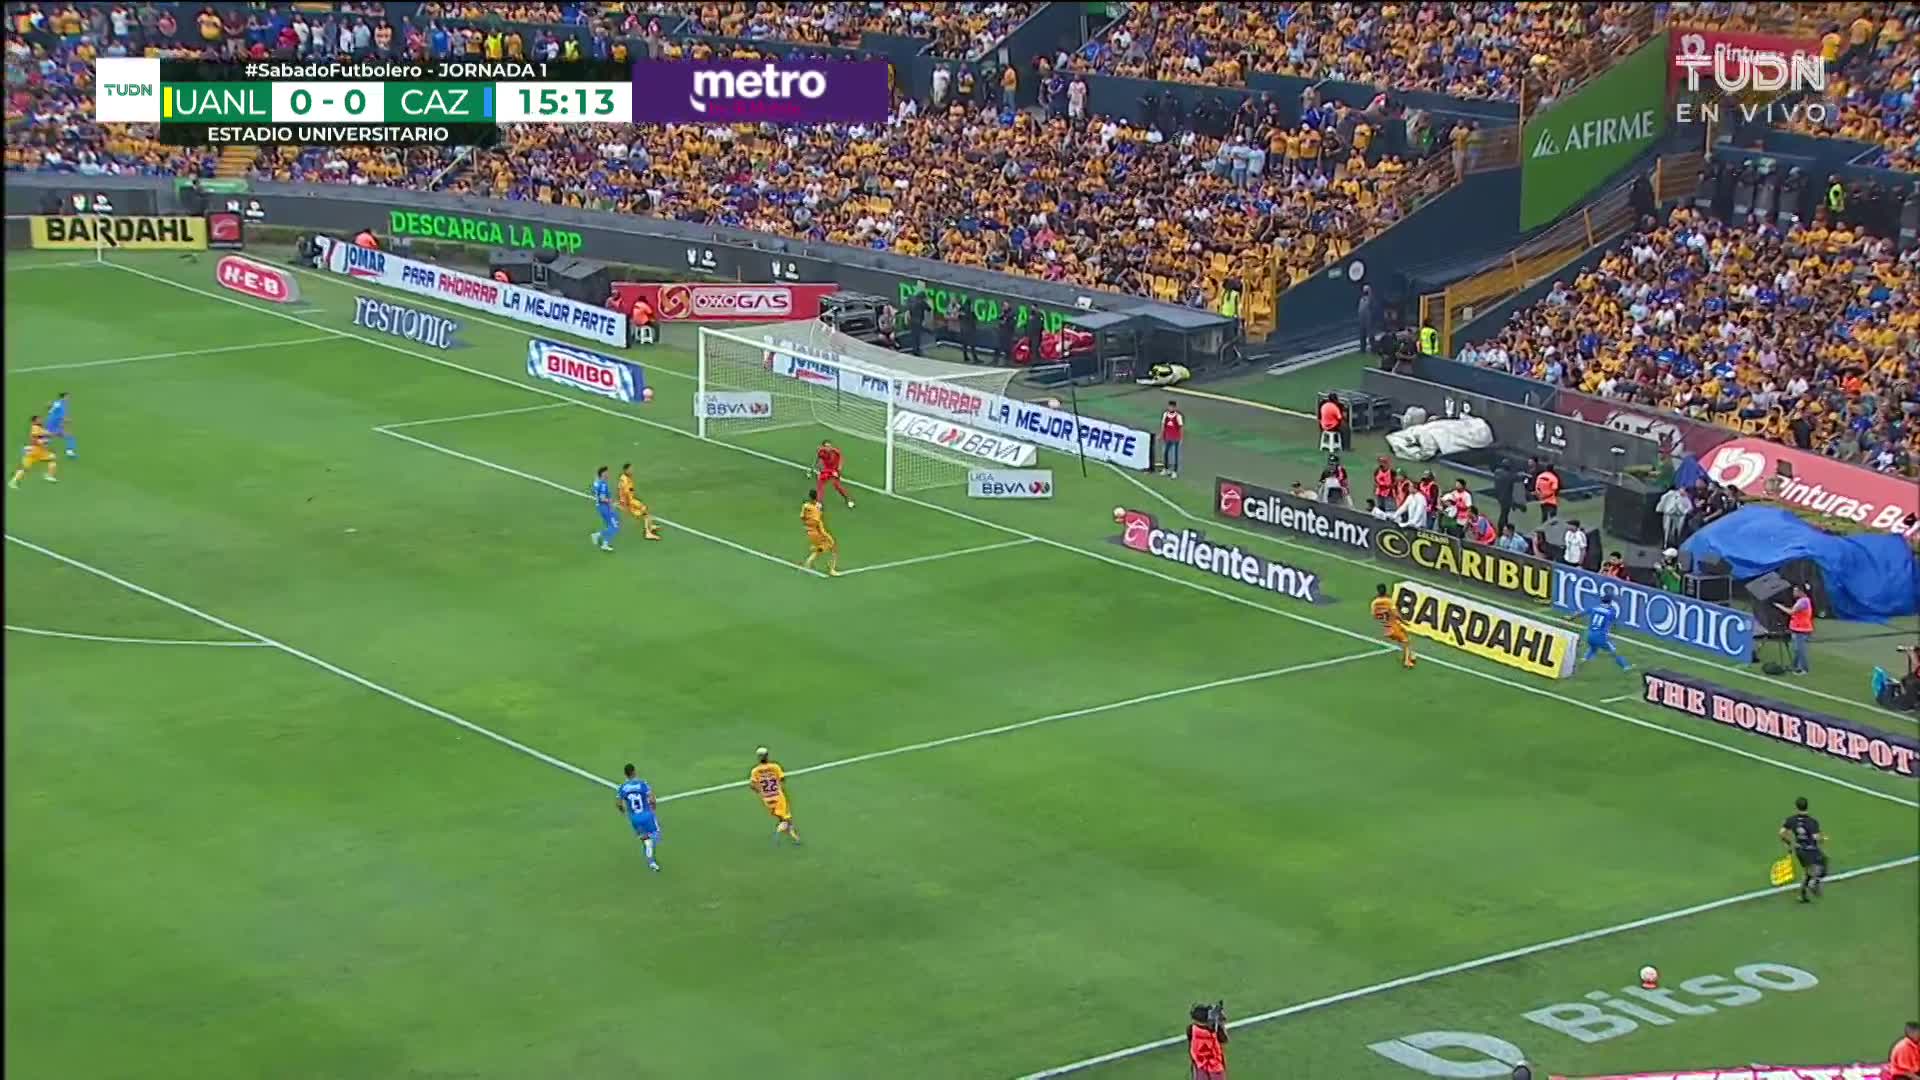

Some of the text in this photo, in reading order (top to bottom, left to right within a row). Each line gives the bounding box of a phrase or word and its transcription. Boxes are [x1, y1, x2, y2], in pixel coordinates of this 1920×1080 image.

[1564, 109, 1656, 152] AFIRME
[46, 218, 195, 248] BARDAHL
[390, 210, 584, 252] DESCARGA LA APP
[343, 244, 386, 274] JOMAR
[402, 265, 617, 337] PARA AHORRAR LA MEJOR PARTE
[546, 354, 614, 388] BIMBO
[905, 381, 982, 417] AHORRAR
[987, 399, 1010, 425] LA
[1015, 409, 1074, 439] MEJOR
[1079, 424, 1137, 457] PARTE
[961, 433, 1022, 463] BBVA
[970, 472, 996, 482] LIGA
[982, 482, 1027, 495] BBVA
[1243, 495, 1370, 550] caliente.mx
[1147, 527, 1316, 602] caliente.mx
[1410, 536, 1549, 599] CARIBU
[1396, 587, 1556, 668] BARDAHL
[1645, 674, 1914, 775] THE HOME DEPOT
[1520, 961, 1819, 1044] Bitso
